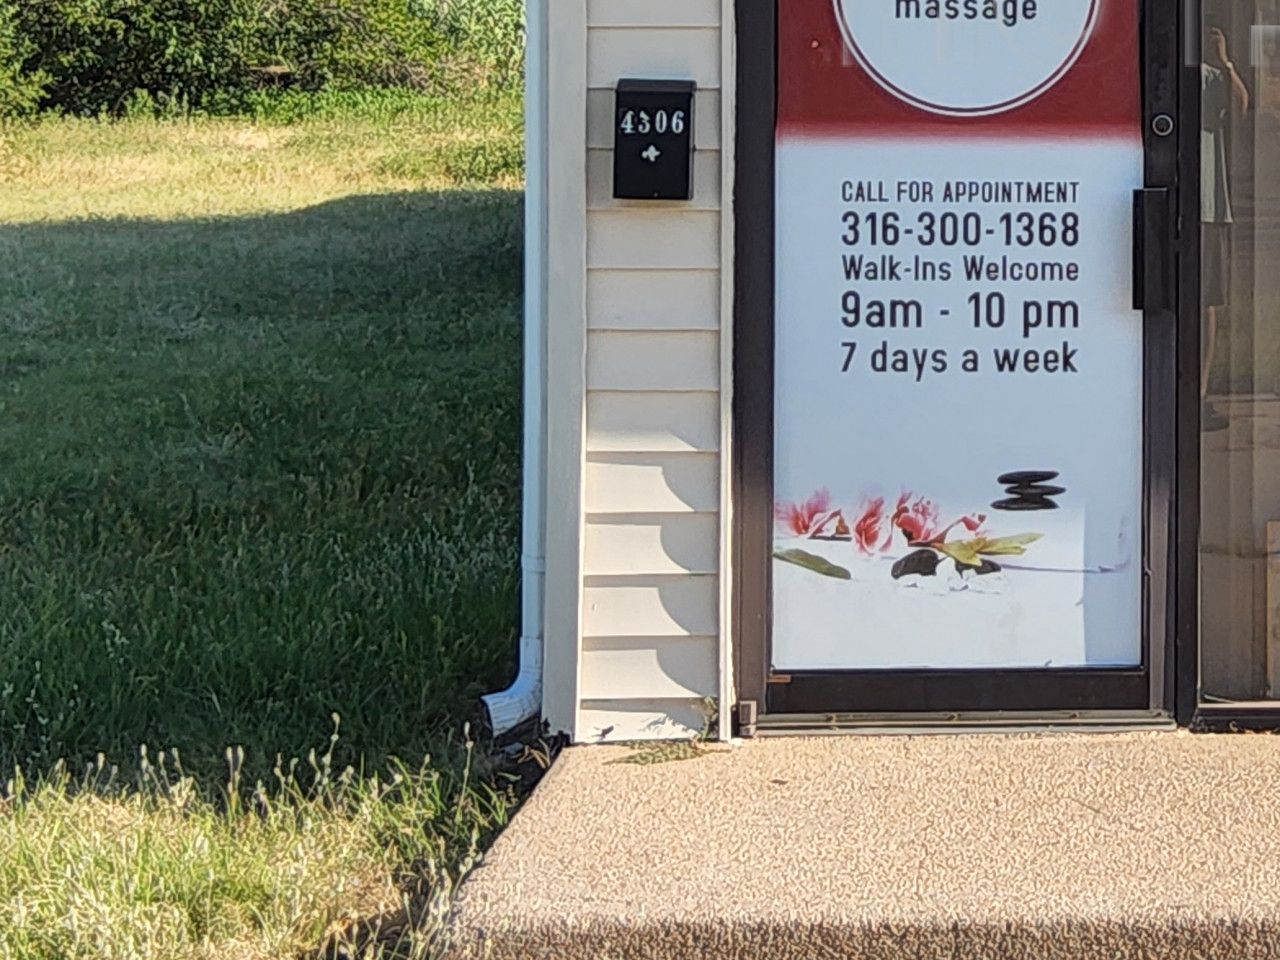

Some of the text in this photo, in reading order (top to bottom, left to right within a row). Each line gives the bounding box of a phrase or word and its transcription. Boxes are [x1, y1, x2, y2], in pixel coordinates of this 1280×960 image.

[620, 110, 685, 134] 4306
[841, 181, 1080, 203] CALL FOR APPOINTMENT
[841, 211, 1080, 246] 316-300-1368
[842, 254, 1080, 281] Walk-Ins Welcome
[841, 290, 923, 328] 9am
[967, 291, 1006, 328] 10
[1022, 299, 1080, 338] pm
[841, 341, 1078, 382] 7 days a week
